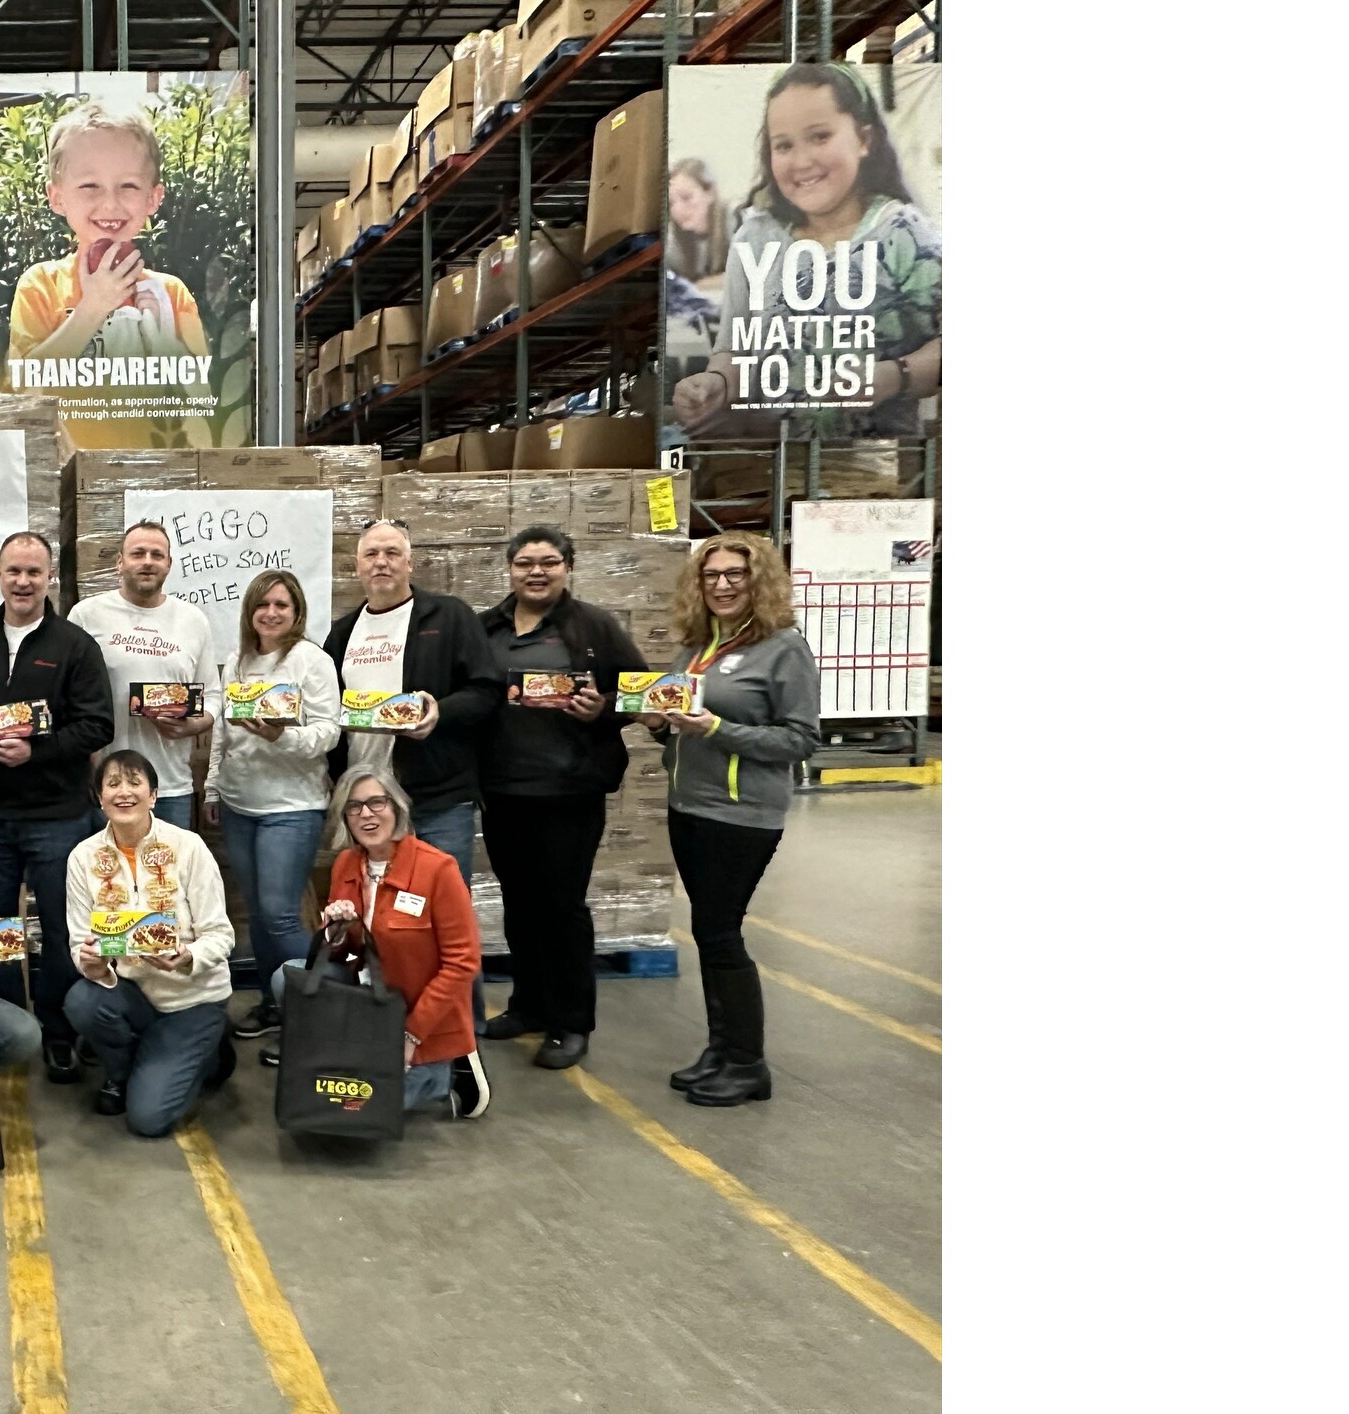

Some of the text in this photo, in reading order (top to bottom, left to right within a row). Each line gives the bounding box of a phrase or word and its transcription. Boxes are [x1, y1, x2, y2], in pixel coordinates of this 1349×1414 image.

[733, 239, 878, 311] YOU
[731, 315, 876, 351] MATTER
[8, 355, 213, 388] TRANSPARENCY
[731, 354, 875, 398] TO US!
[71, 409, 109, 421] through
[112, 409, 145, 419] candid
[147, 408, 215, 418] conversations
[186, 395, 219, 407] openly
[180, 548, 293, 579] FEED SOME
[109, 633, 148, 647] Better
[316, 1079, 373, 1097] L'EGGO
